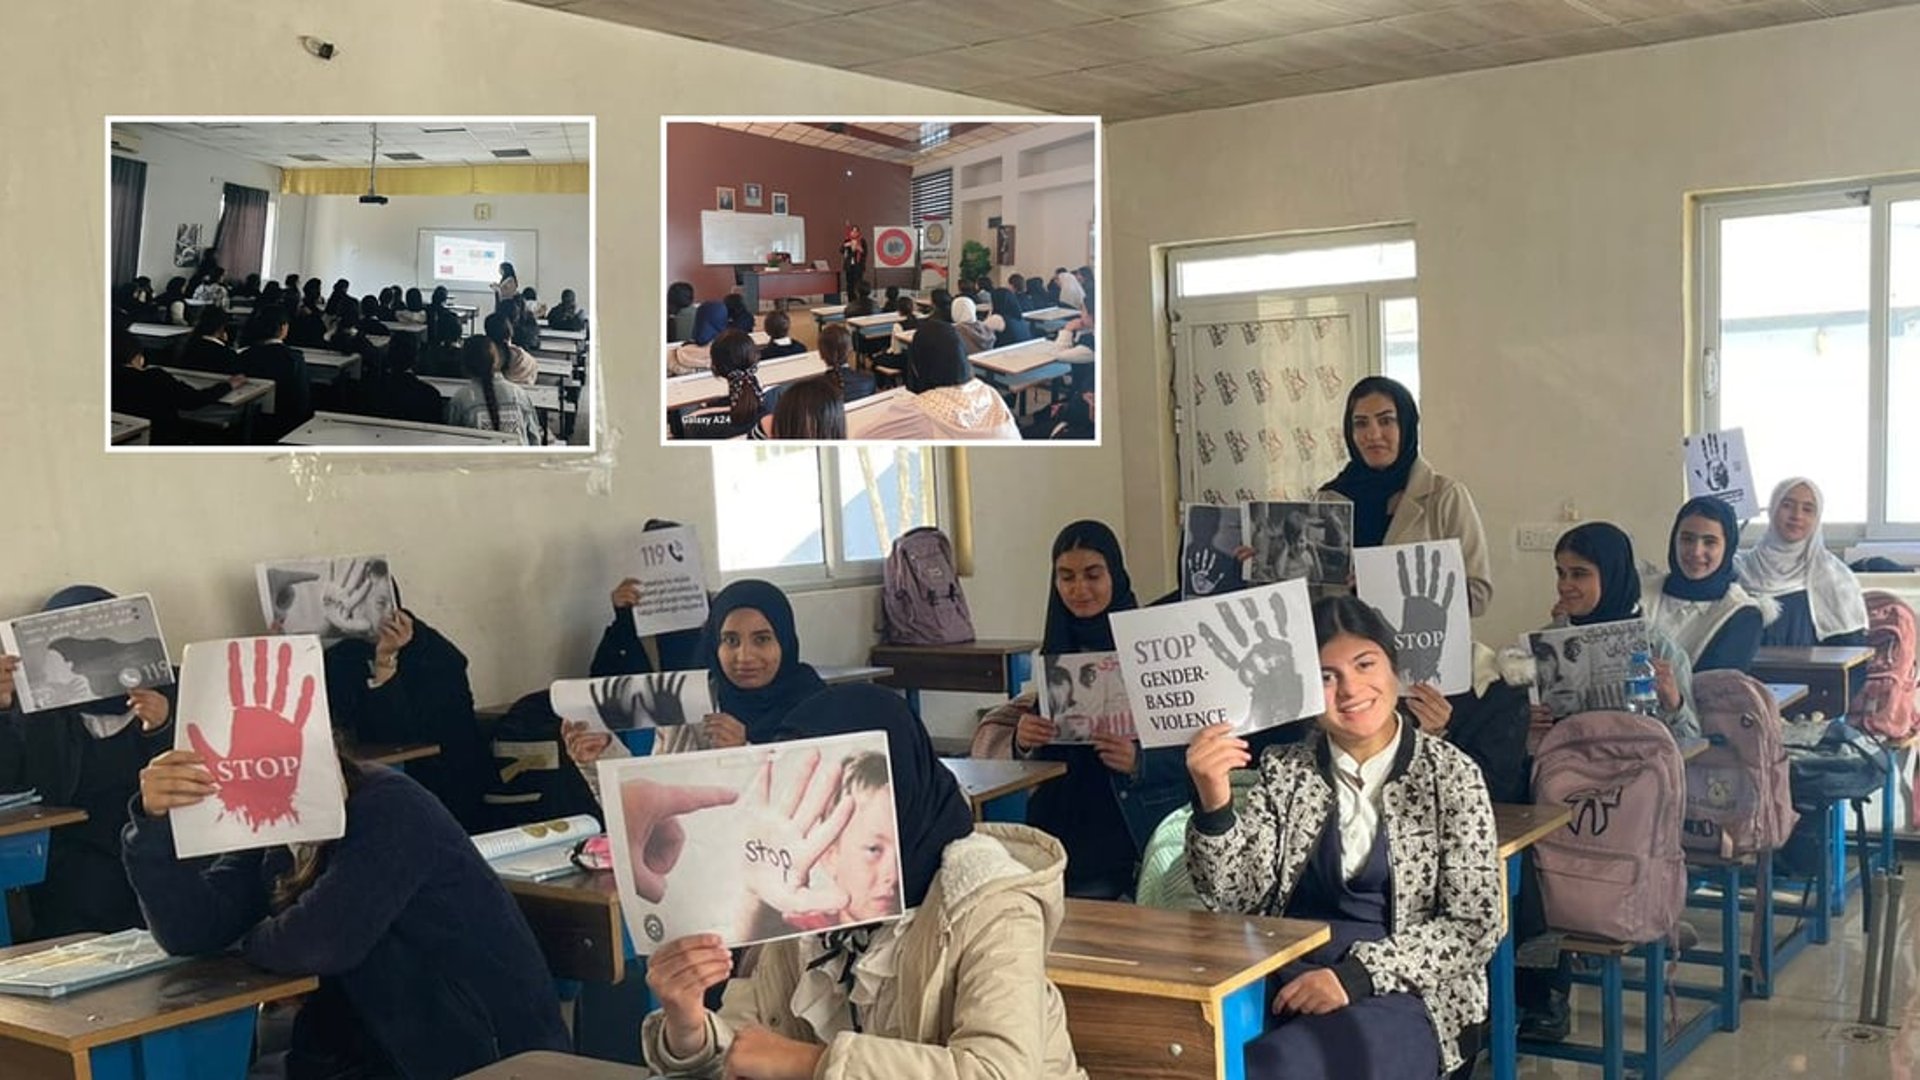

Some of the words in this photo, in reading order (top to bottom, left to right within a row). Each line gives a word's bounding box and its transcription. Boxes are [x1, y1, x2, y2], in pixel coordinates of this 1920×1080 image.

[642, 545, 665, 567] 119
[1134, 634, 1196, 664] STOP
[1394, 630, 1444, 650] STOP
[143, 659, 169, 681] 119
[1140, 665, 1209, 688] GENDER-
[1144, 690, 1195, 710] BASED
[1149, 708, 1227, 730] VIOLENCE
[217, 756, 299, 782] STOP
